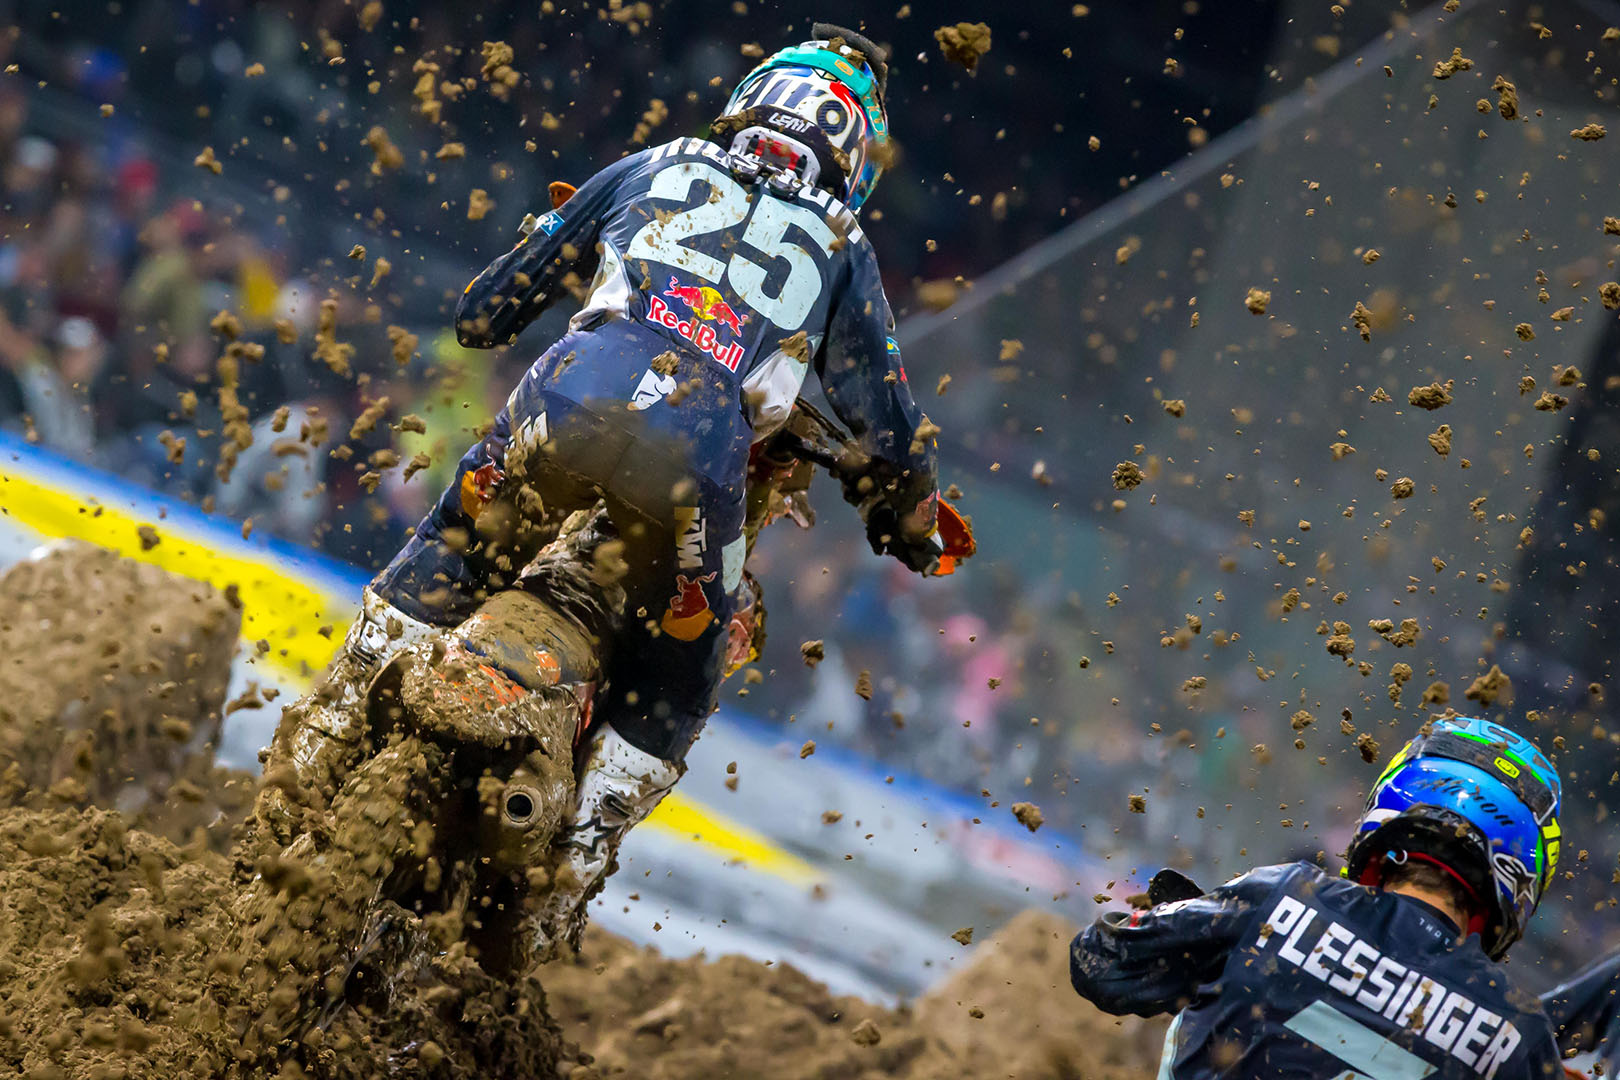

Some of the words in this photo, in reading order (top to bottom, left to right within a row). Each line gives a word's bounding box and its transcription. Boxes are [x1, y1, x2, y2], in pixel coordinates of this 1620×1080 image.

[627, 162, 838, 331] 25
[674, 506, 707, 569] KTM
[1256, 895, 1522, 1080] PLESSINGER
